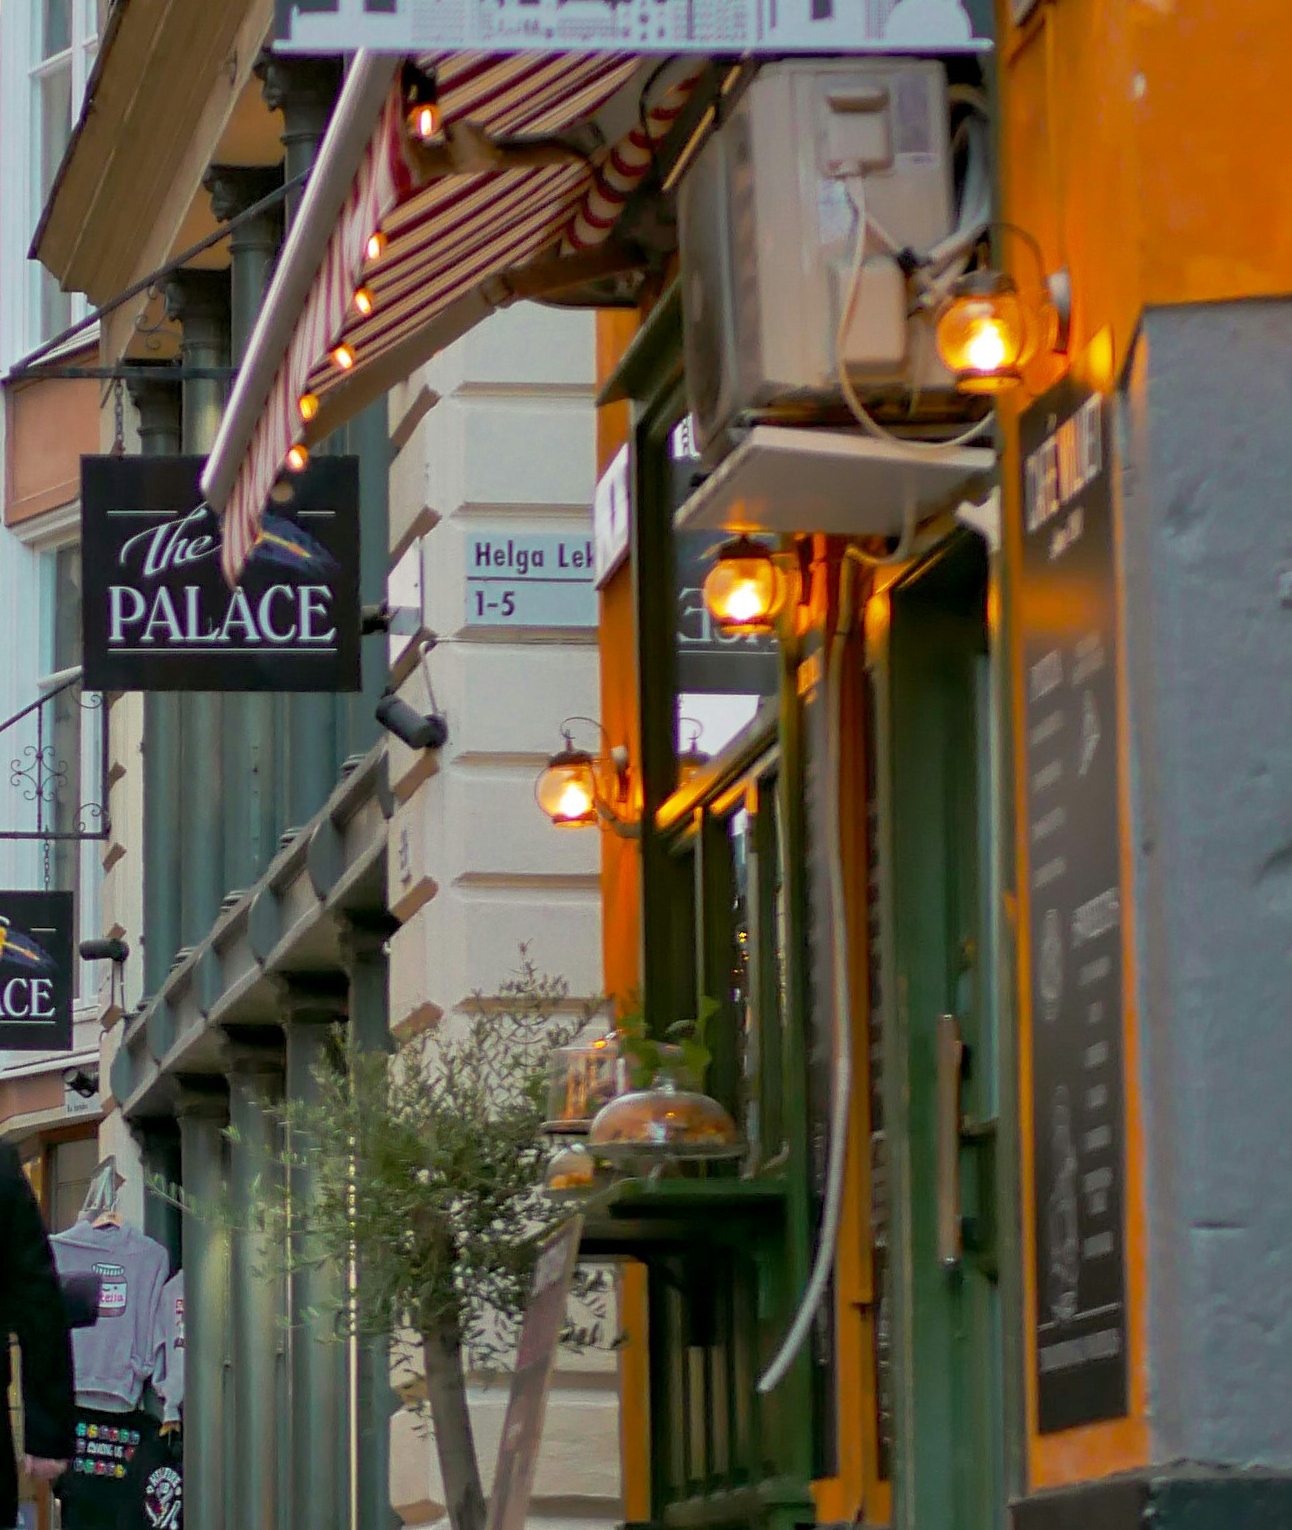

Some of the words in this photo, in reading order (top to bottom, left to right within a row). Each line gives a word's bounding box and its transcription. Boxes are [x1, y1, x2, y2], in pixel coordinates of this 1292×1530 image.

[119, 501, 222, 577] The
[474, 539, 544, 575] Helga
[108, 584, 337, 643] PALACE
[475, 590, 516, 617] 1-5
